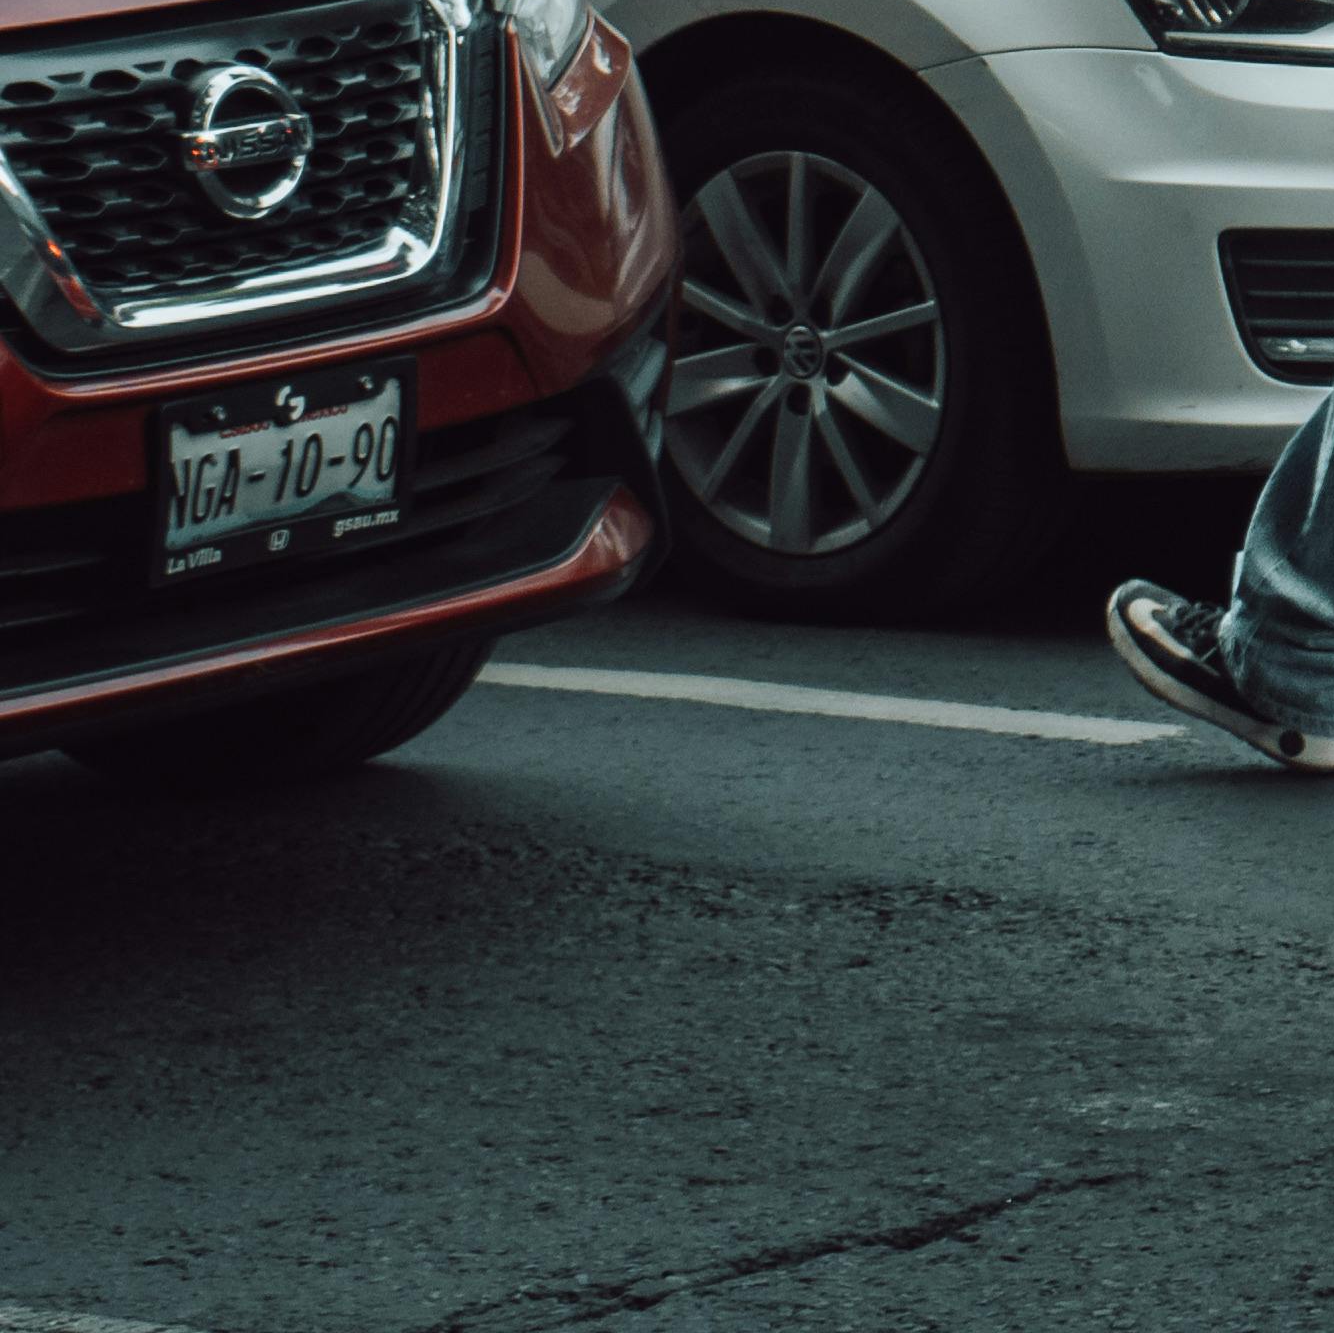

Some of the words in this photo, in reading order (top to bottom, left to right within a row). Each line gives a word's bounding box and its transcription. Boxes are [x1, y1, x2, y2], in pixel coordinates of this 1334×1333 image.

[333, 509, 400, 537] gsau.mx
[166, 557, 186, 575] La
[188, 547, 222, 569] Villa
